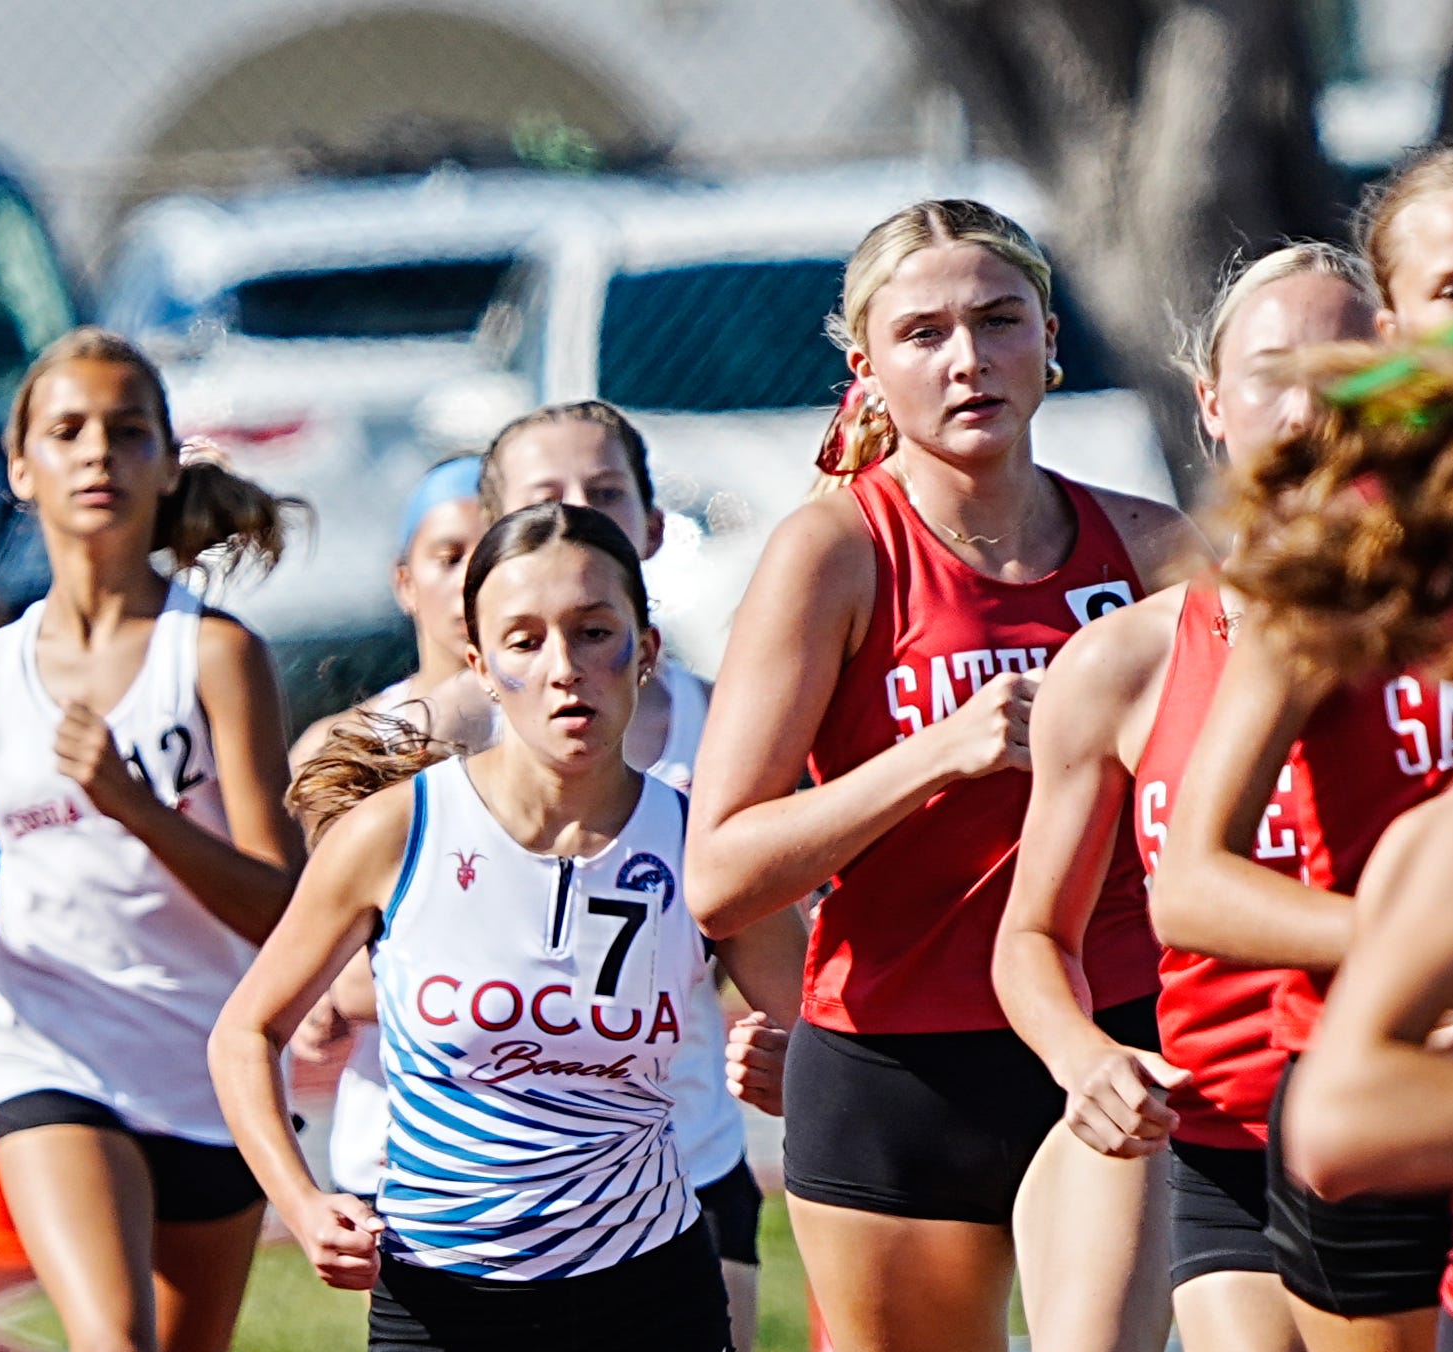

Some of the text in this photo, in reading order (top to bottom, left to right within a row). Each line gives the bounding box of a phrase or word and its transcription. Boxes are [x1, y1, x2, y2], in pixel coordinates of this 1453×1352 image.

[588, 896, 648, 998] 7
[417, 975, 680, 1044] COCOA
[470, 1041, 632, 1084] Beach
